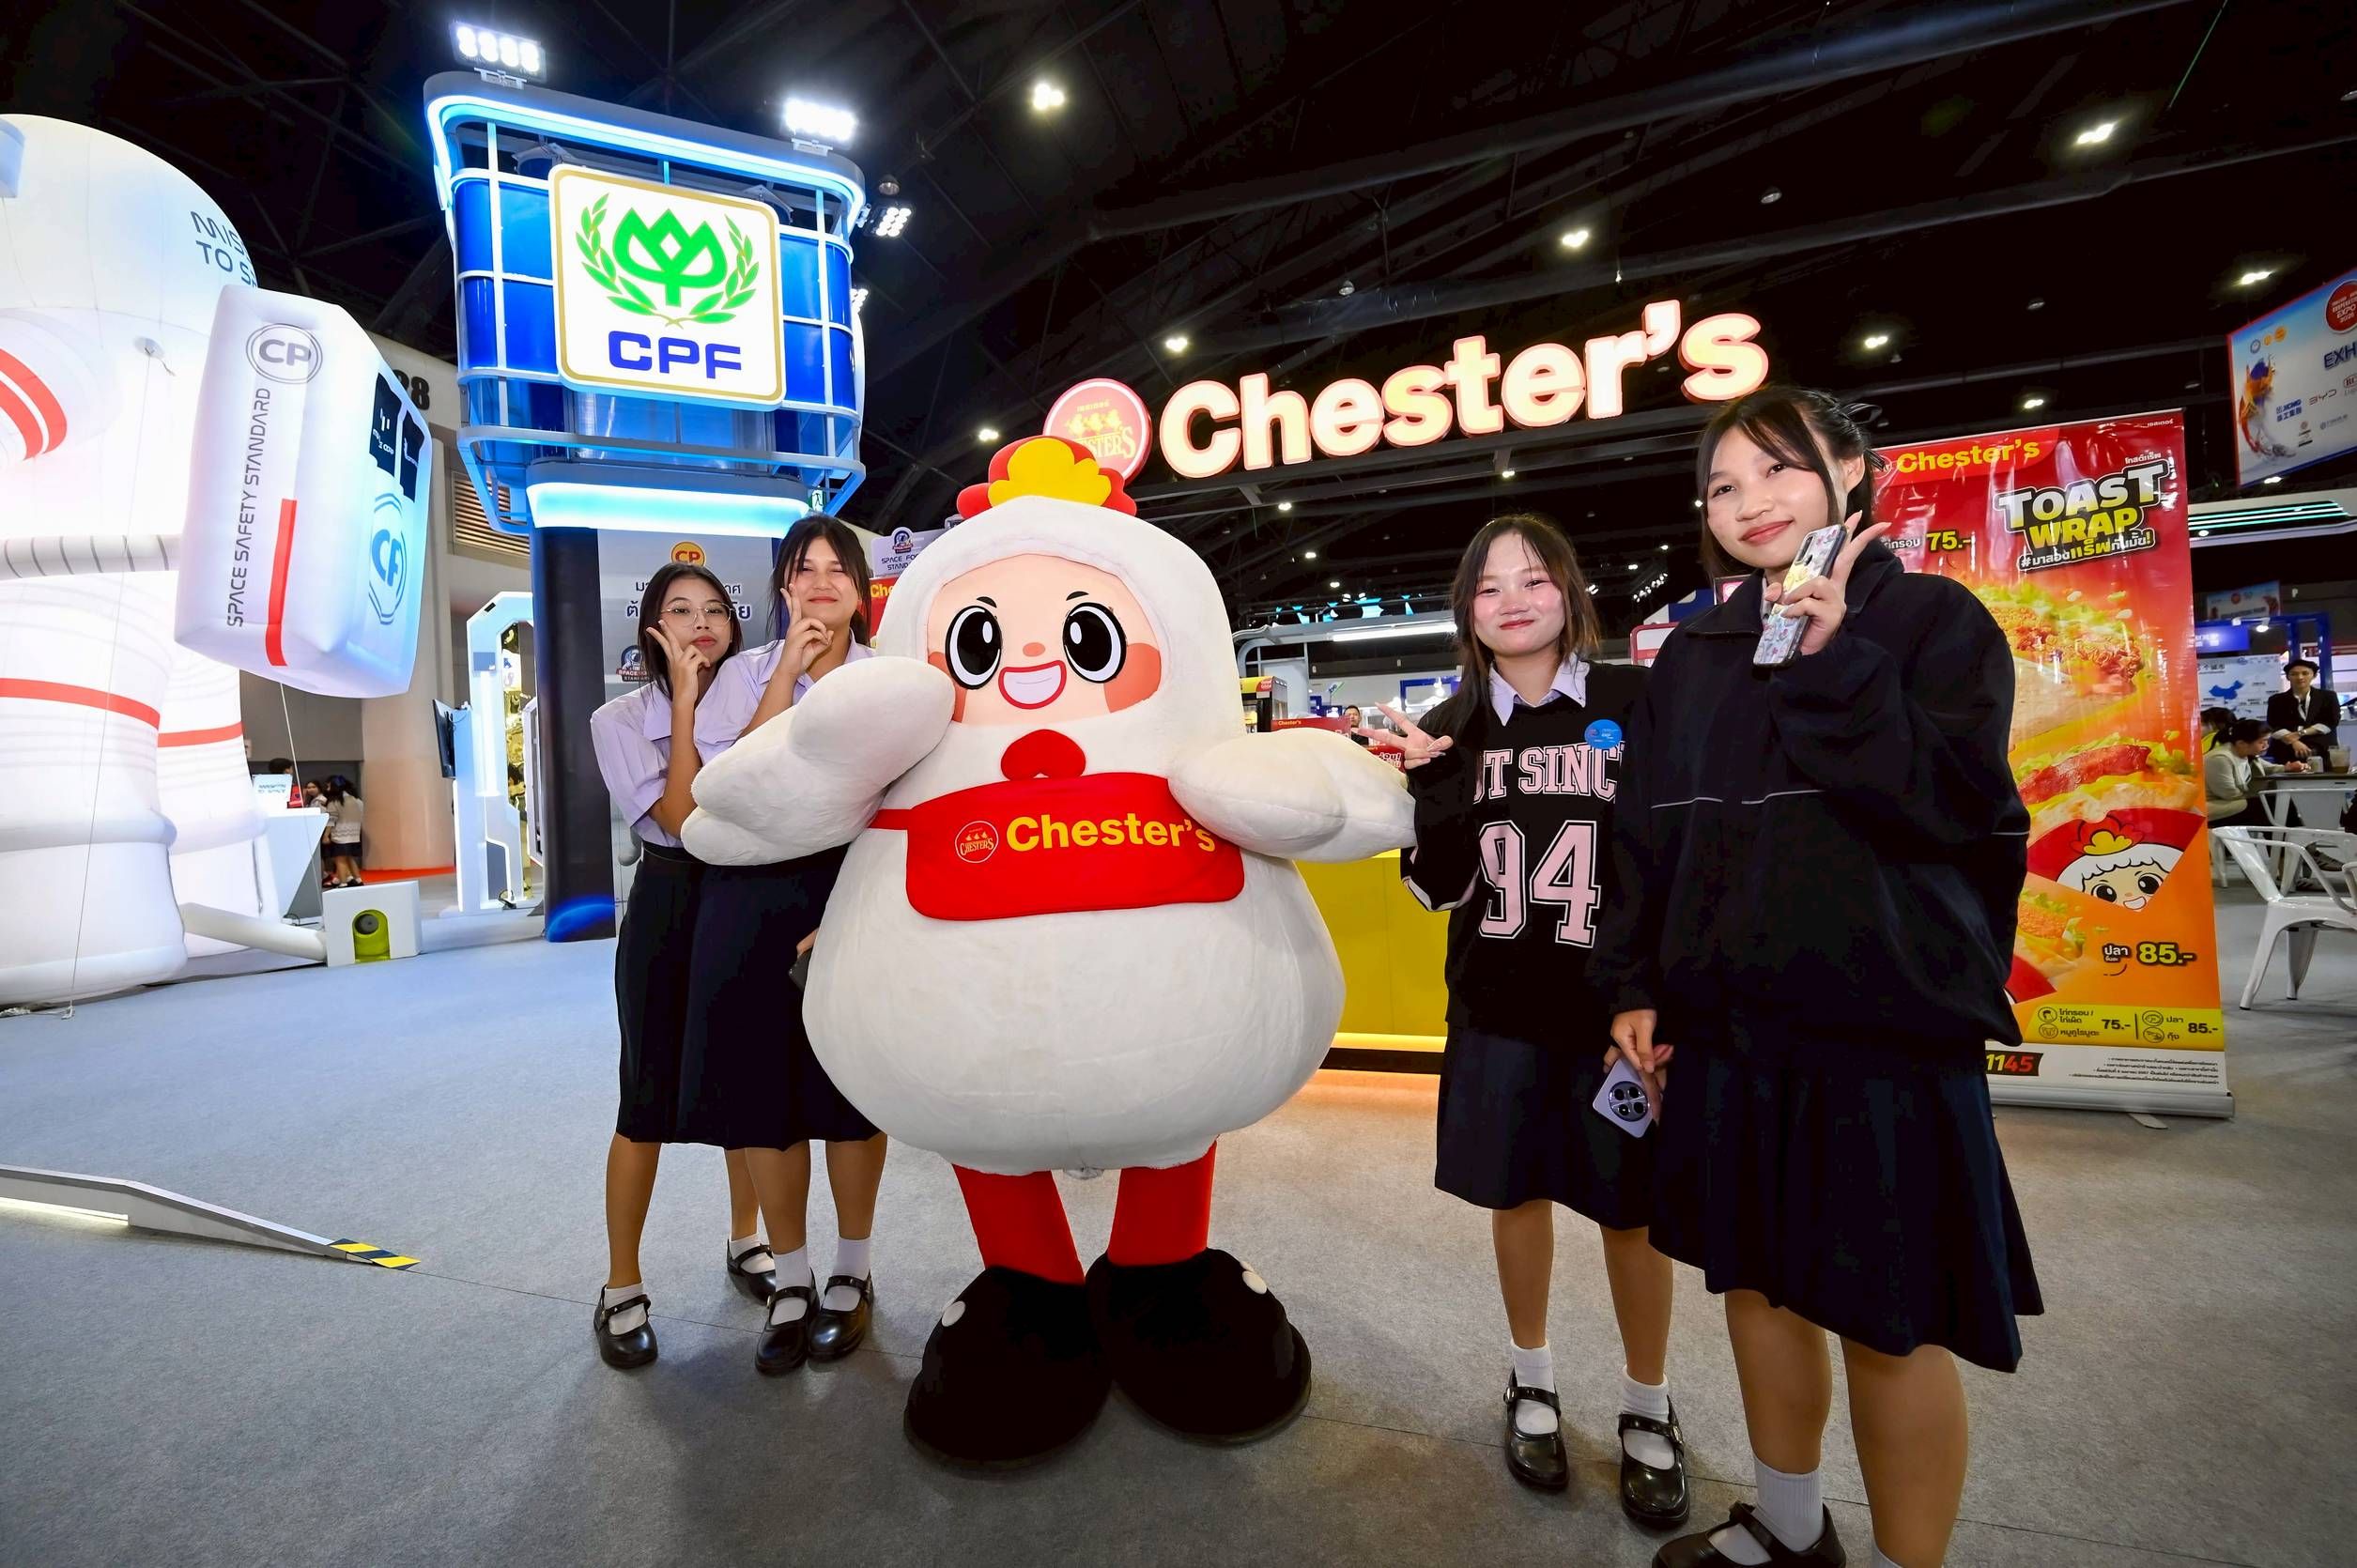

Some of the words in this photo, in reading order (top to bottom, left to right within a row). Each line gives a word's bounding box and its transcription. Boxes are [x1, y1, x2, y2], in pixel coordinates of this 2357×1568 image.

[191, 210, 250, 264] MIS
[195, 239, 233, 272] TO
[258, 339, 311, 366] CP
[608, 330, 742, 379] CPF
[1159, 299, 1769, 480] Chester's
[2309, 389, 2337, 406] BYD
[244, 387, 271, 486] STANDARD
[1896, 438, 2041, 474] Chester's
[1998, 463, 2165, 530] TOAST
[235, 491, 257, 562] SAFETY
[2028, 506, 2138, 550] WRAP
[674, 550, 701, 564] CP
[881, 554, 902, 564] SPACE
[226, 566, 248, 627] SPACE
[1517, 740, 1626, 803] SINC
[1006, 812, 1216, 853] Chester's
[1478, 819, 1602, 949] 94
[2103, 945, 2130, 957] ปลา
[2139, 943, 2194, 964] 85.-
[2102, 1019, 2131, 1030] 75.-
[2166, 1014, 2184, 1023] ปลา
[2188, 1022, 2219, 1034] 85.-
